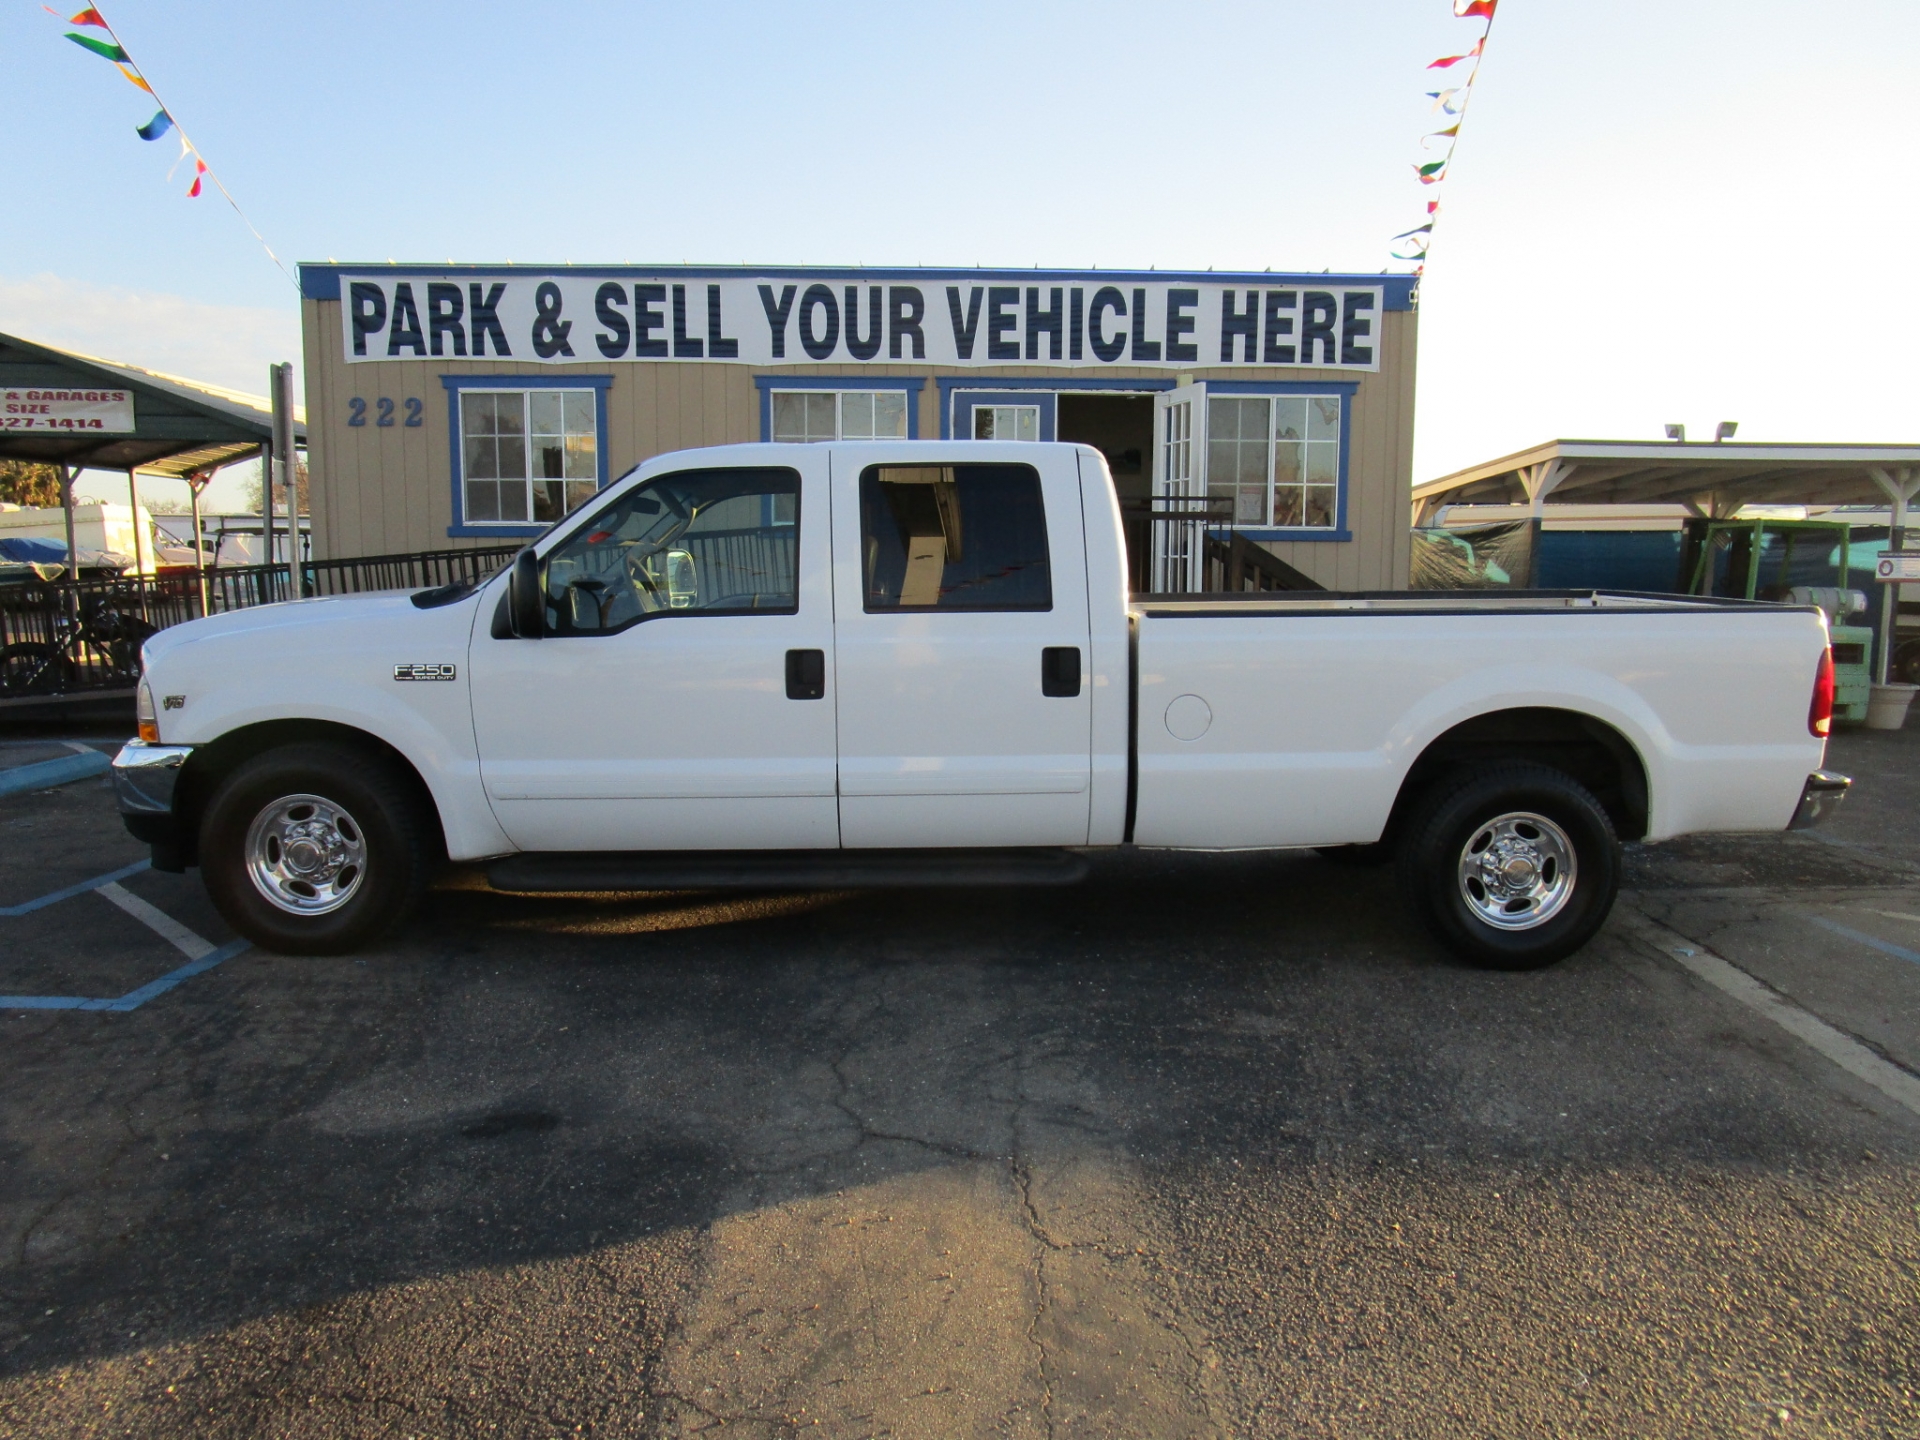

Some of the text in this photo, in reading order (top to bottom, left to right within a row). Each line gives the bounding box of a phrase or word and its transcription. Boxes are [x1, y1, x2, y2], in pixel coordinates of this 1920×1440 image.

[350, 281, 1375, 365] PARK & SELL YOUR VEHICLE HERE
[5, 390, 125, 402] & GARAGES
[6, 404, 50, 414] SIZE
[348, 397, 423, 427] 222
[0, 417, 104, 429] 27-1414
